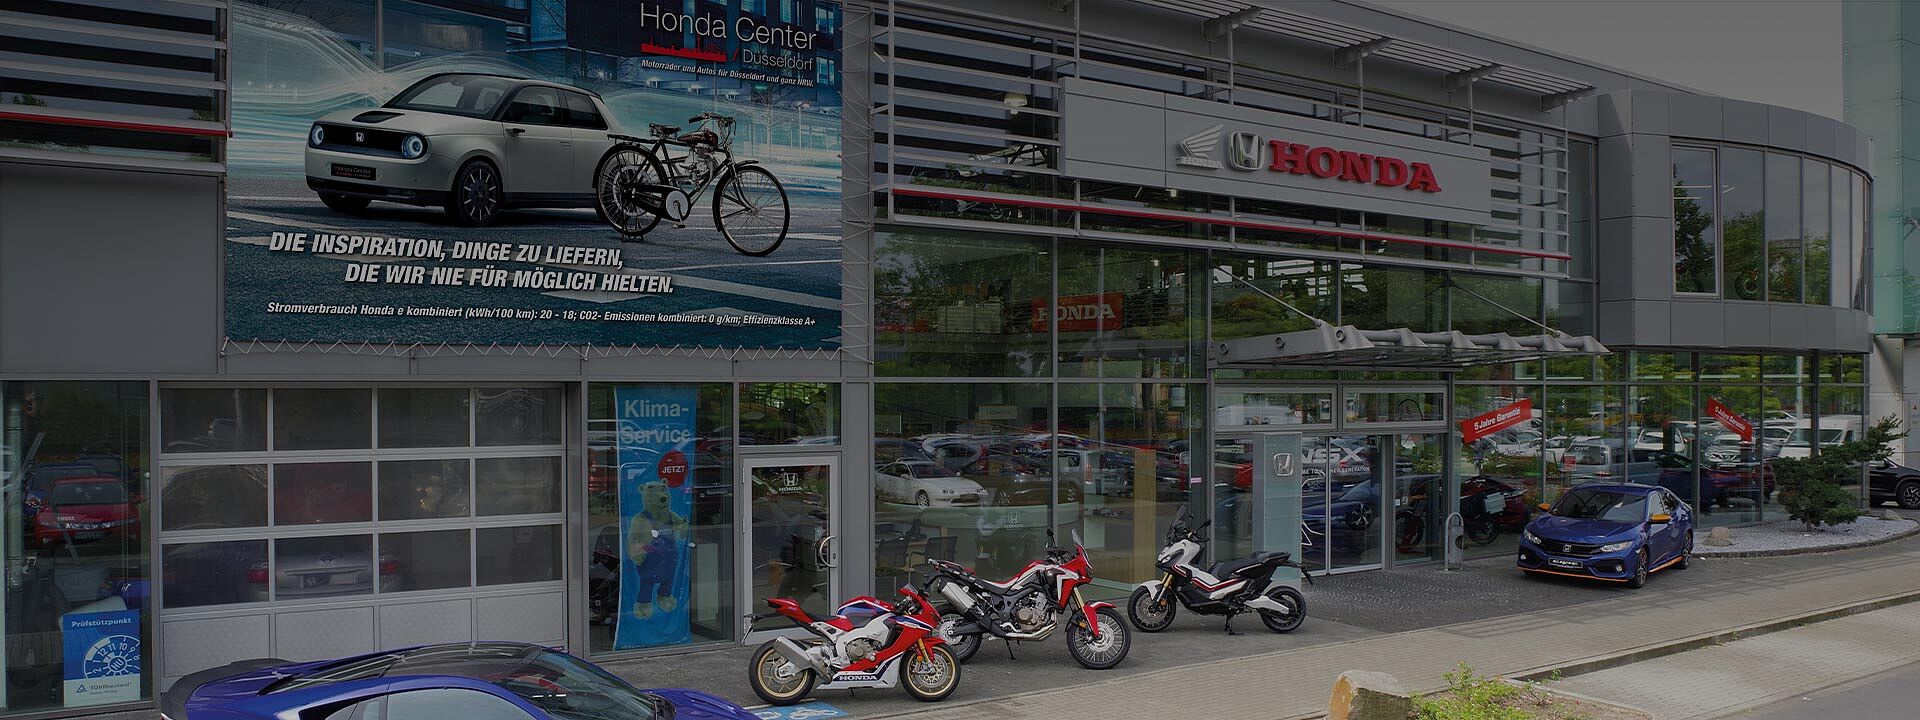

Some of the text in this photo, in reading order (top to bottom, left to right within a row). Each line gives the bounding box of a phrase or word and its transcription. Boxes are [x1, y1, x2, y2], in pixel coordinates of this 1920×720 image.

[640, 2, 817, 50] Honda Center
[743, 49, 813, 71] Düsseldorf
[682, 63, 696, 73] und
[697, 66, 716, 75] Autos
[717, 68, 728, 77] für
[729, 69, 766, 81] Düsseldorf
[766, 74, 779, 83] und
[780, 76, 796, 85] ganz
[797, 78, 814, 88] NRW.
[1268, 139, 1442, 193] HONDA
[269, 231, 623, 270] DIE INSPIRATION, DINGE ZU LIEFERN,
[345, 263, 674, 294] DIE WIR NIE FÜR MÖGLICH HIELTEN.
[267, 302, 357, 315] Stromverbrauch
[360, 305, 394, 316] Honda
[397, 307, 403, 315] e
[406, 305, 462, 317] kombiniert
[465, 307, 513, 320] (kWh/100
[515, 308, 538, 320] km):
[540, 310, 552, 319] 20
[562, 310, 577, 321] 18;
[579, 310, 602, 320] CO2-
[603, 311, 656, 322] Emissionen
[657, 312, 707, 323] kombiniert:
[708, 315, 714, 323] 0
[716, 315, 741, 325] g/km;
[743, 315, 803, 326] Effizienzklasse
[805, 316, 816, 325] A+
[1037, 303, 1116, 321] HONDA
[624, 399, 689, 418] Klima-
[1473, 421, 1479, 430] 5
[1479, 417, 1496, 429] Jahre
[620, 425, 691, 445] Service
[662, 465, 686, 474] JETZT
[71, 617, 132, 628] Prüfstützpunkt
[108, 643, 116, 651] 11
[119, 643, 127, 651] 10
